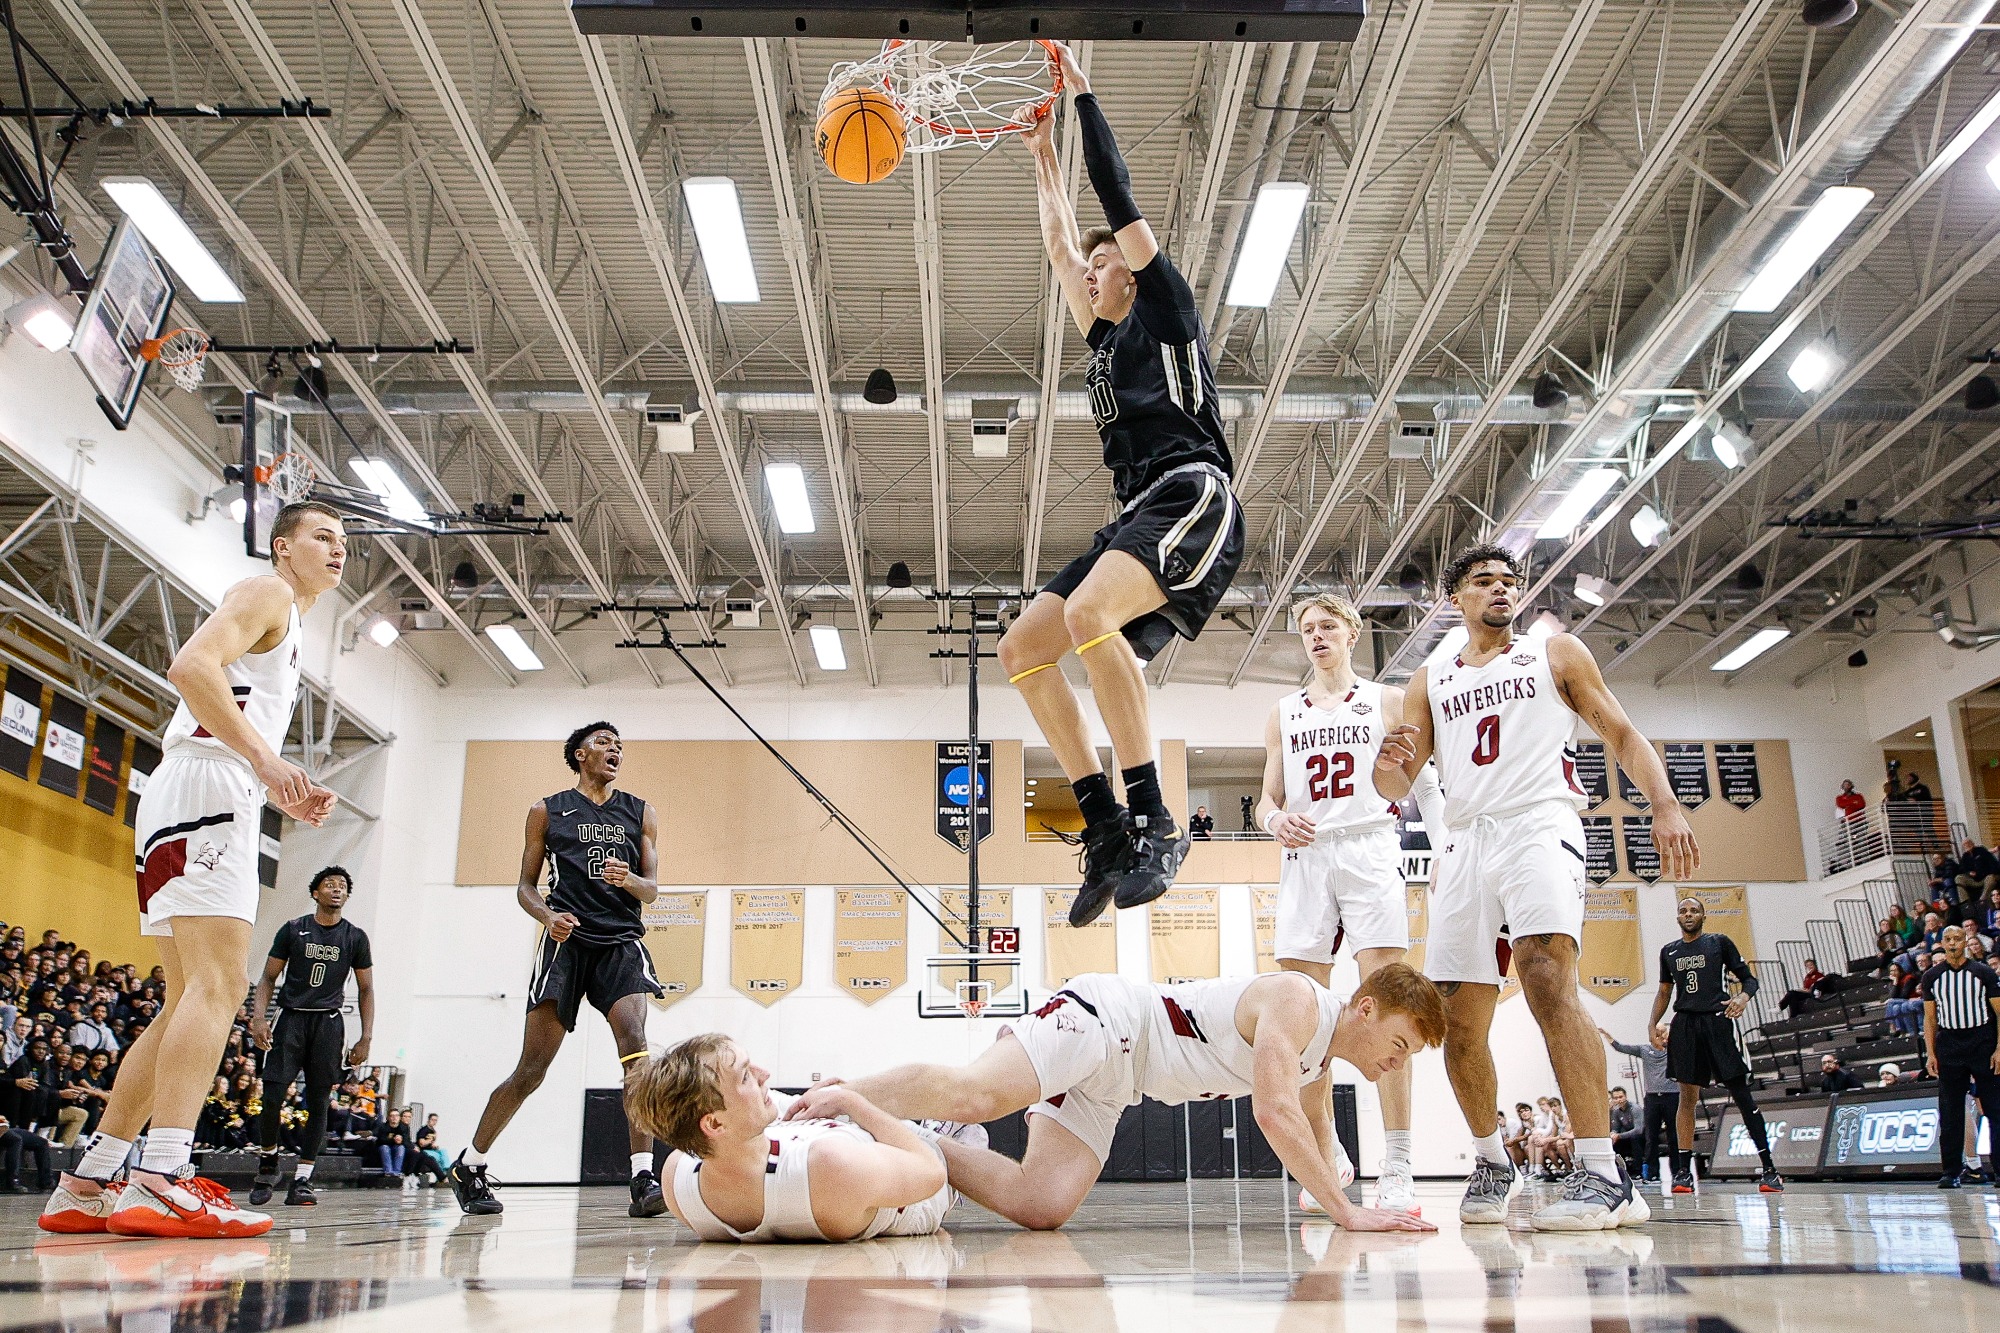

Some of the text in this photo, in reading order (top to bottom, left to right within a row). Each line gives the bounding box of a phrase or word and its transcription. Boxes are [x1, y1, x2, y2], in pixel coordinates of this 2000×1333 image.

[1441, 676, 1536, 723] MAVERICKS
[1290, 725, 1370, 754] MAVERICKS
[1472, 714, 1500, 767] 0
[1305, 752, 1355, 802] 22
[1678, 794, 1704, 804] UCCS
[1729, 794, 1755, 804] UCCS
[939, 807, 989, 815] FINAL FUR
[949, 816, 970, 826] 201
[577, 823, 626, 844] UCCS
[1402, 857, 1432, 876] NT
[991, 931, 1017, 953] 22
[305, 942, 340, 962] UCCS
[1675, 954, 1706, 971] UCCS
[309, 962, 327, 988] 0
[848, 977, 891, 989] UCCS
[1590, 976, 1630, 987] UCCS
[1686, 970, 1699, 994] 3
[659, 981, 687, 993] CCS
[746, 979, 788, 991] UCCS
[1789, 1126, 1822, 1142] UCCS
[1858, 1107, 1940, 1155] UCCS
